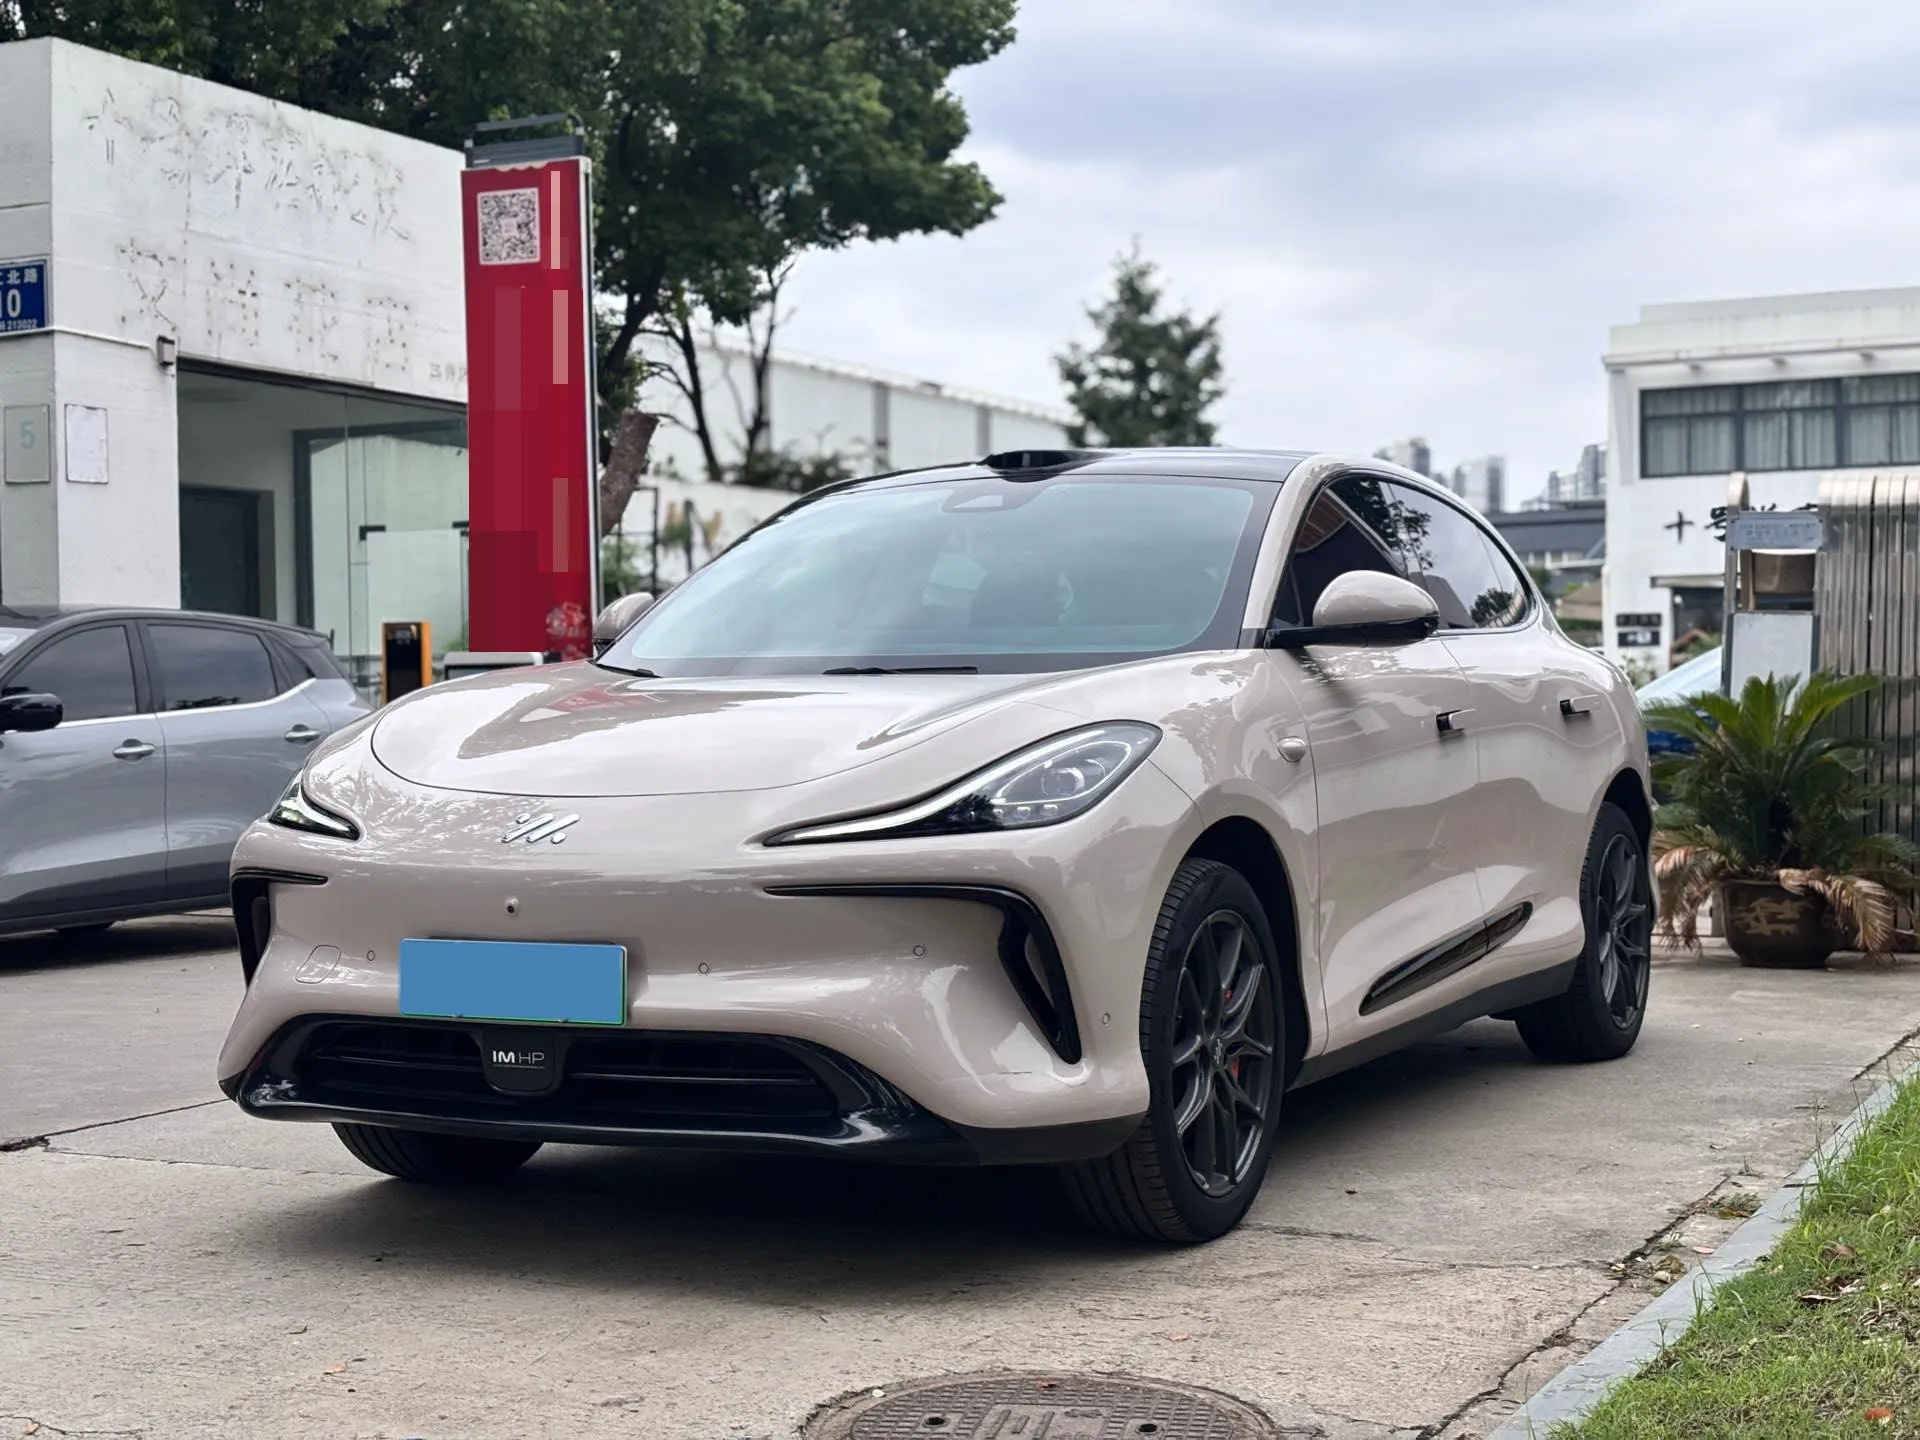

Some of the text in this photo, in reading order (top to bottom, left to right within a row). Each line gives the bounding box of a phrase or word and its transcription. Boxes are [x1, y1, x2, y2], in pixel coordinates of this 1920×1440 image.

[20, 420, 35, 450] 5
[492, 1050, 545, 1064] IM HP
